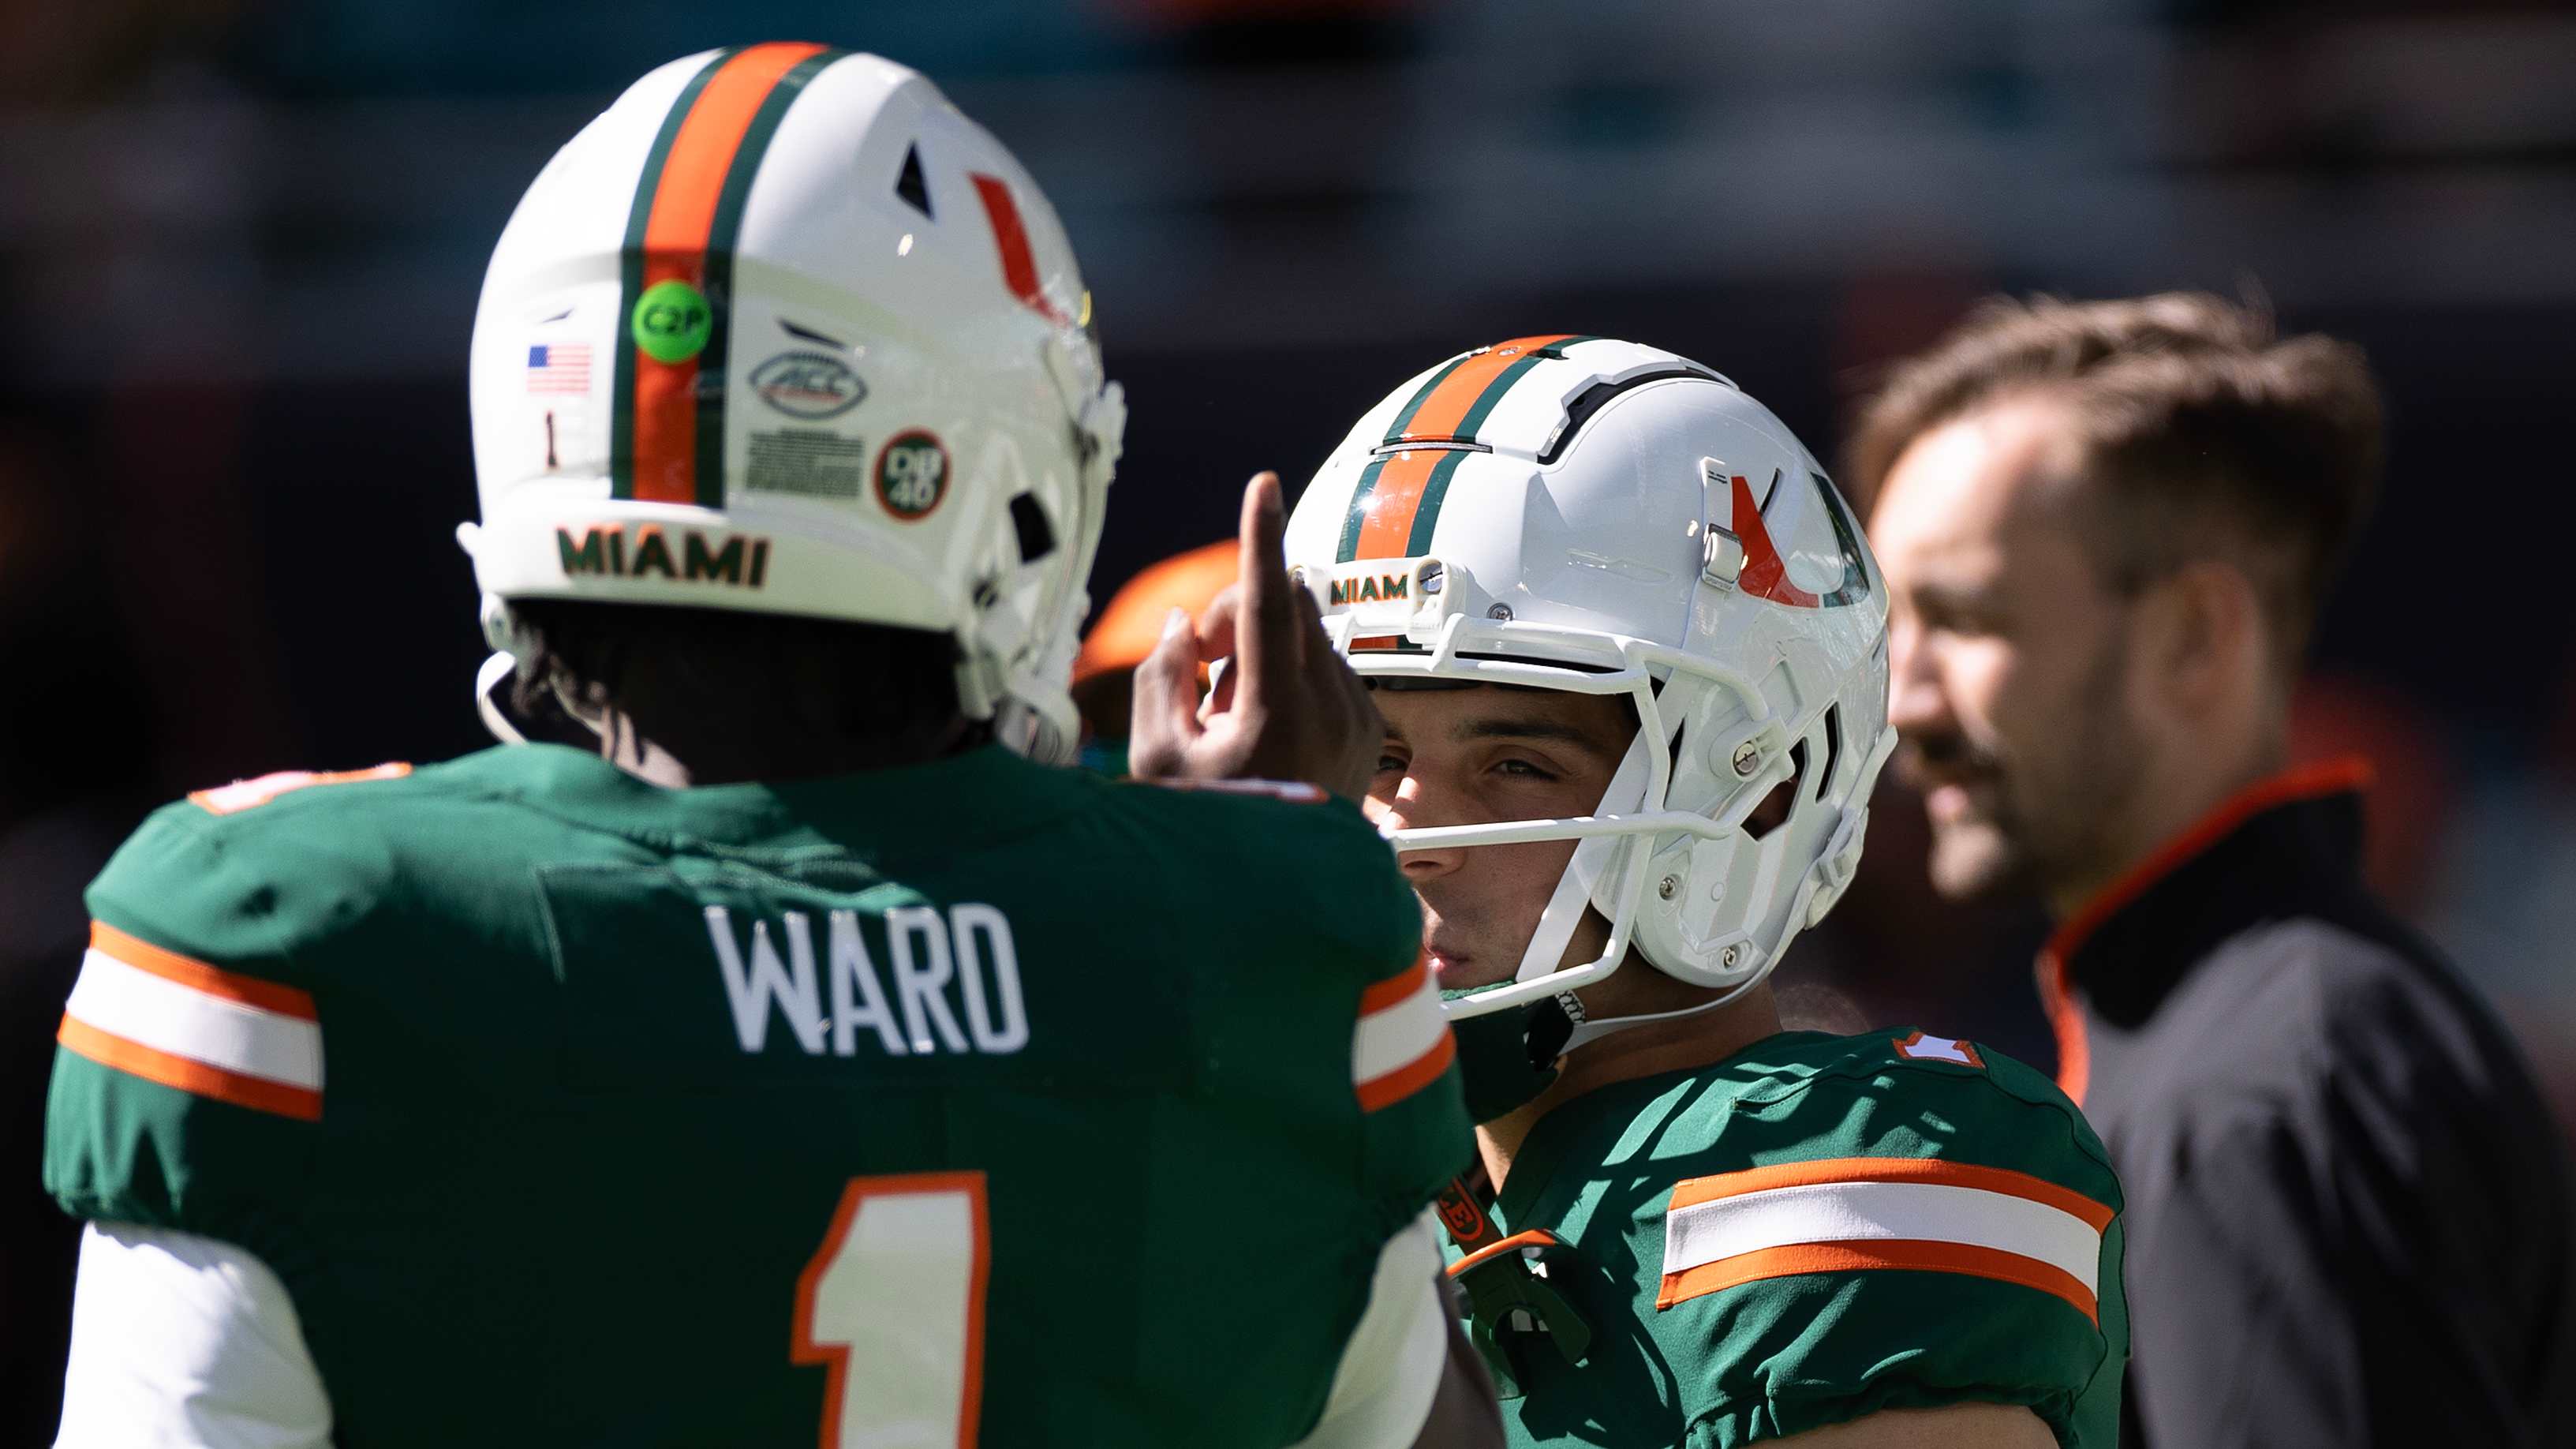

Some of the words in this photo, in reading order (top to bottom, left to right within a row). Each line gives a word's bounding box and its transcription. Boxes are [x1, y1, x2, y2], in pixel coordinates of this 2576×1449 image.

[768, 365, 852, 398] ACC
[888, 477, 937, 508] 40
[555, 522, 772, 590] MIAMI
[1329, 572, 1409, 606] MIAM
[705, 904, 1030, 1057] WARD
[791, 1170, 992, 1449] 1
